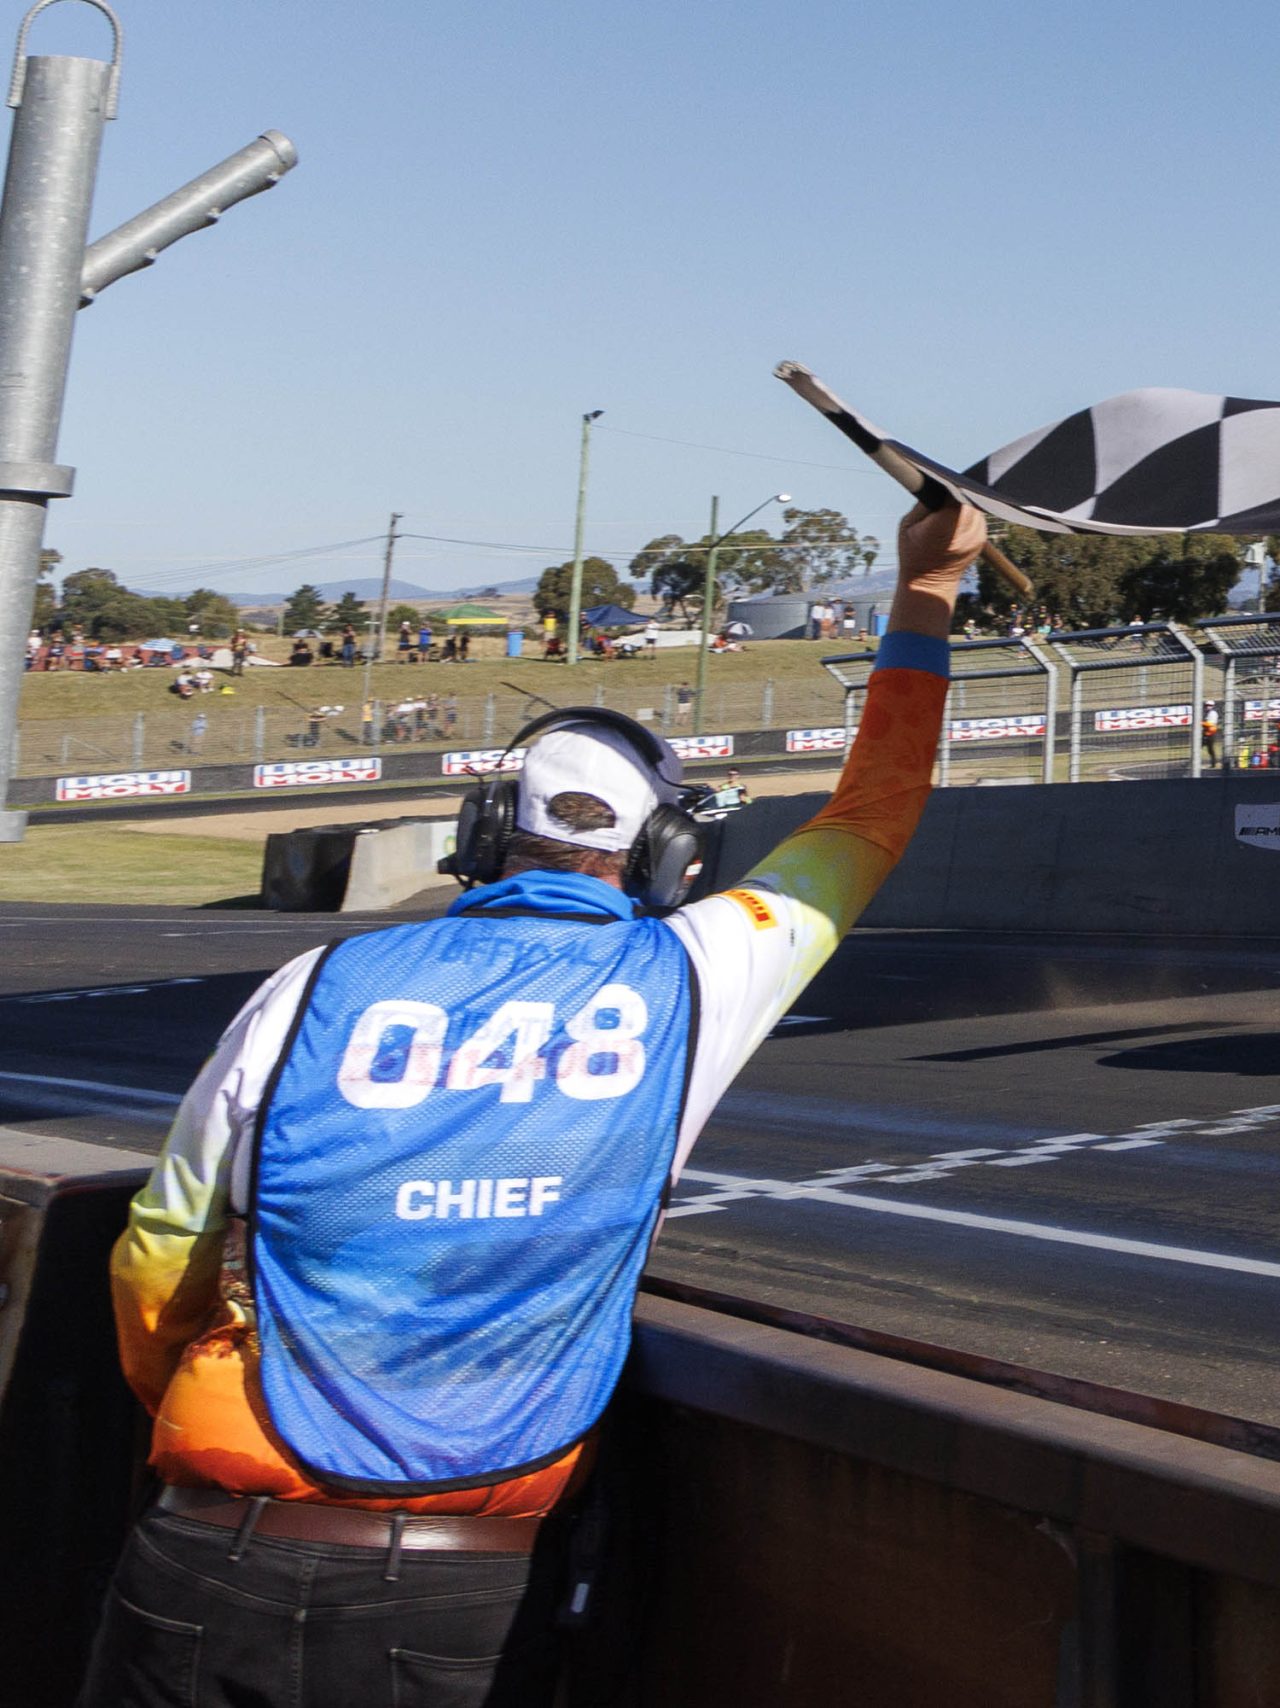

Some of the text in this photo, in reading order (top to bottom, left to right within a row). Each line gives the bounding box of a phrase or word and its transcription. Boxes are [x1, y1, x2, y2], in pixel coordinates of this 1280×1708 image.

[1102, 706, 1187, 720] LIQUI
[1103, 716, 1187, 729] MOLY
[952, 725, 1044, 738] MOLY
[450, 748, 528, 762] LIQU
[264, 758, 377, 775] LIQUI
[65, 771, 187, 787] LIQUI
[264, 770, 375, 787] MOLY
[66, 783, 184, 799] MOLY
[337, 983, 649, 1109] 048
[395, 1175, 562, 1220] CHIEF
